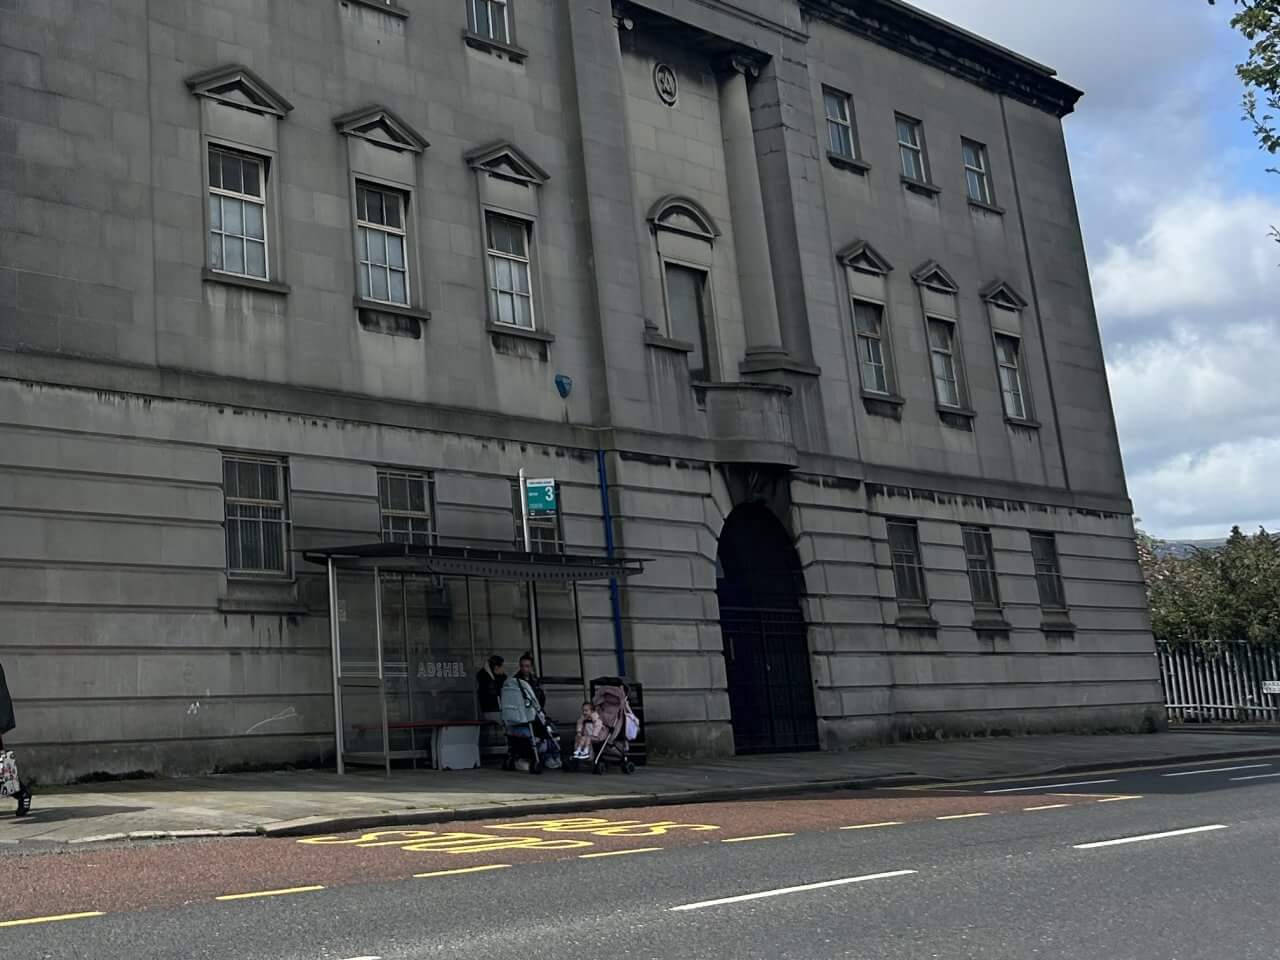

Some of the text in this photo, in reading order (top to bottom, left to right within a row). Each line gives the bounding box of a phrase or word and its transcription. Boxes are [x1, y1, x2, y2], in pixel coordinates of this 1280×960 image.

[545, 486, 554, 501] 3
[416, 661, 466, 678] ADSHEL
[483, 817, 720, 836] BUS
[297, 830, 594, 854] STOP
